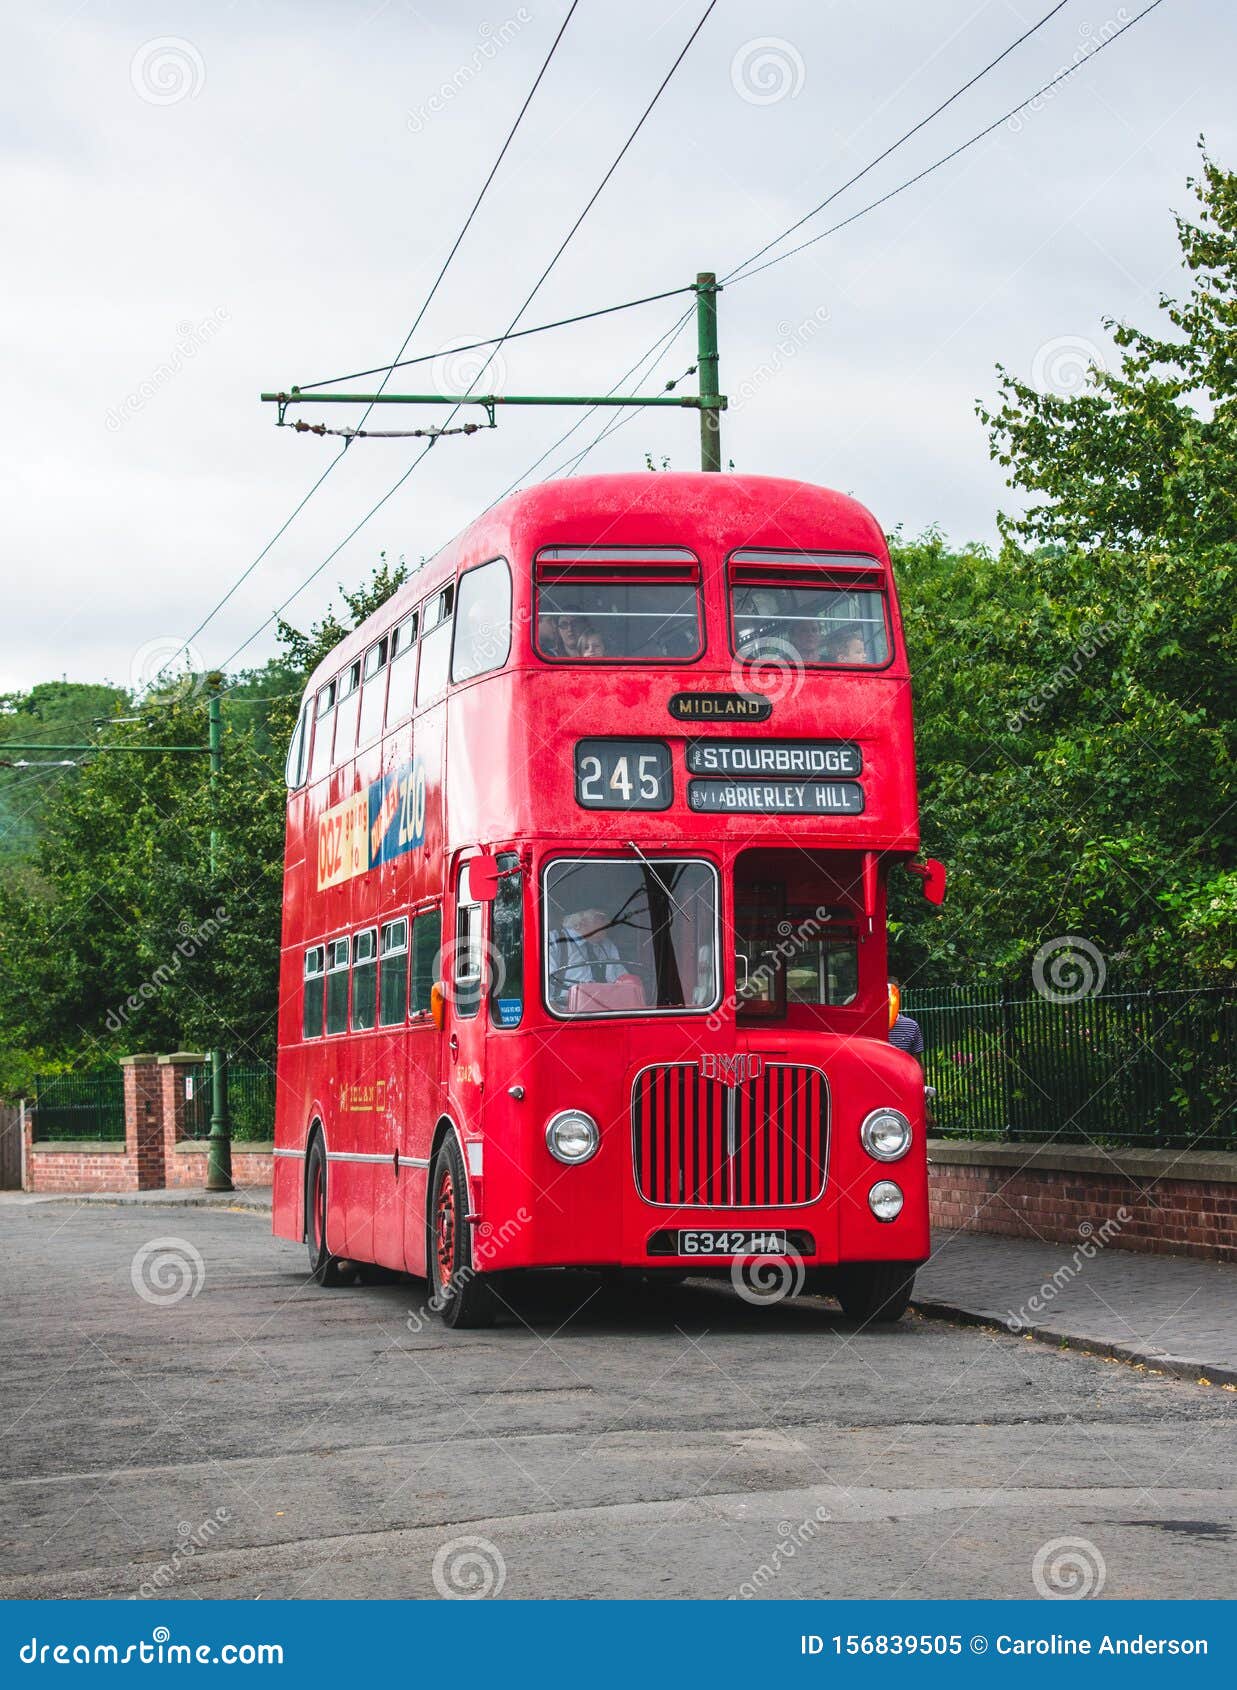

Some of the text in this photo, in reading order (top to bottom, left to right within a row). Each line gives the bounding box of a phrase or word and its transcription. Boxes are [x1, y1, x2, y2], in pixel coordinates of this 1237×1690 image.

[679, 699, 760, 715] MIDLAND
[703, 748, 853, 771] STOURBRIDGE
[581, 755, 659, 801] 245
[398, 763, 426, 847] ZOO
[701, 791, 727, 804] VIA
[725, 787, 805, 808] BRIERLEY
[684, 1232, 780, 1253] 6342 HA
